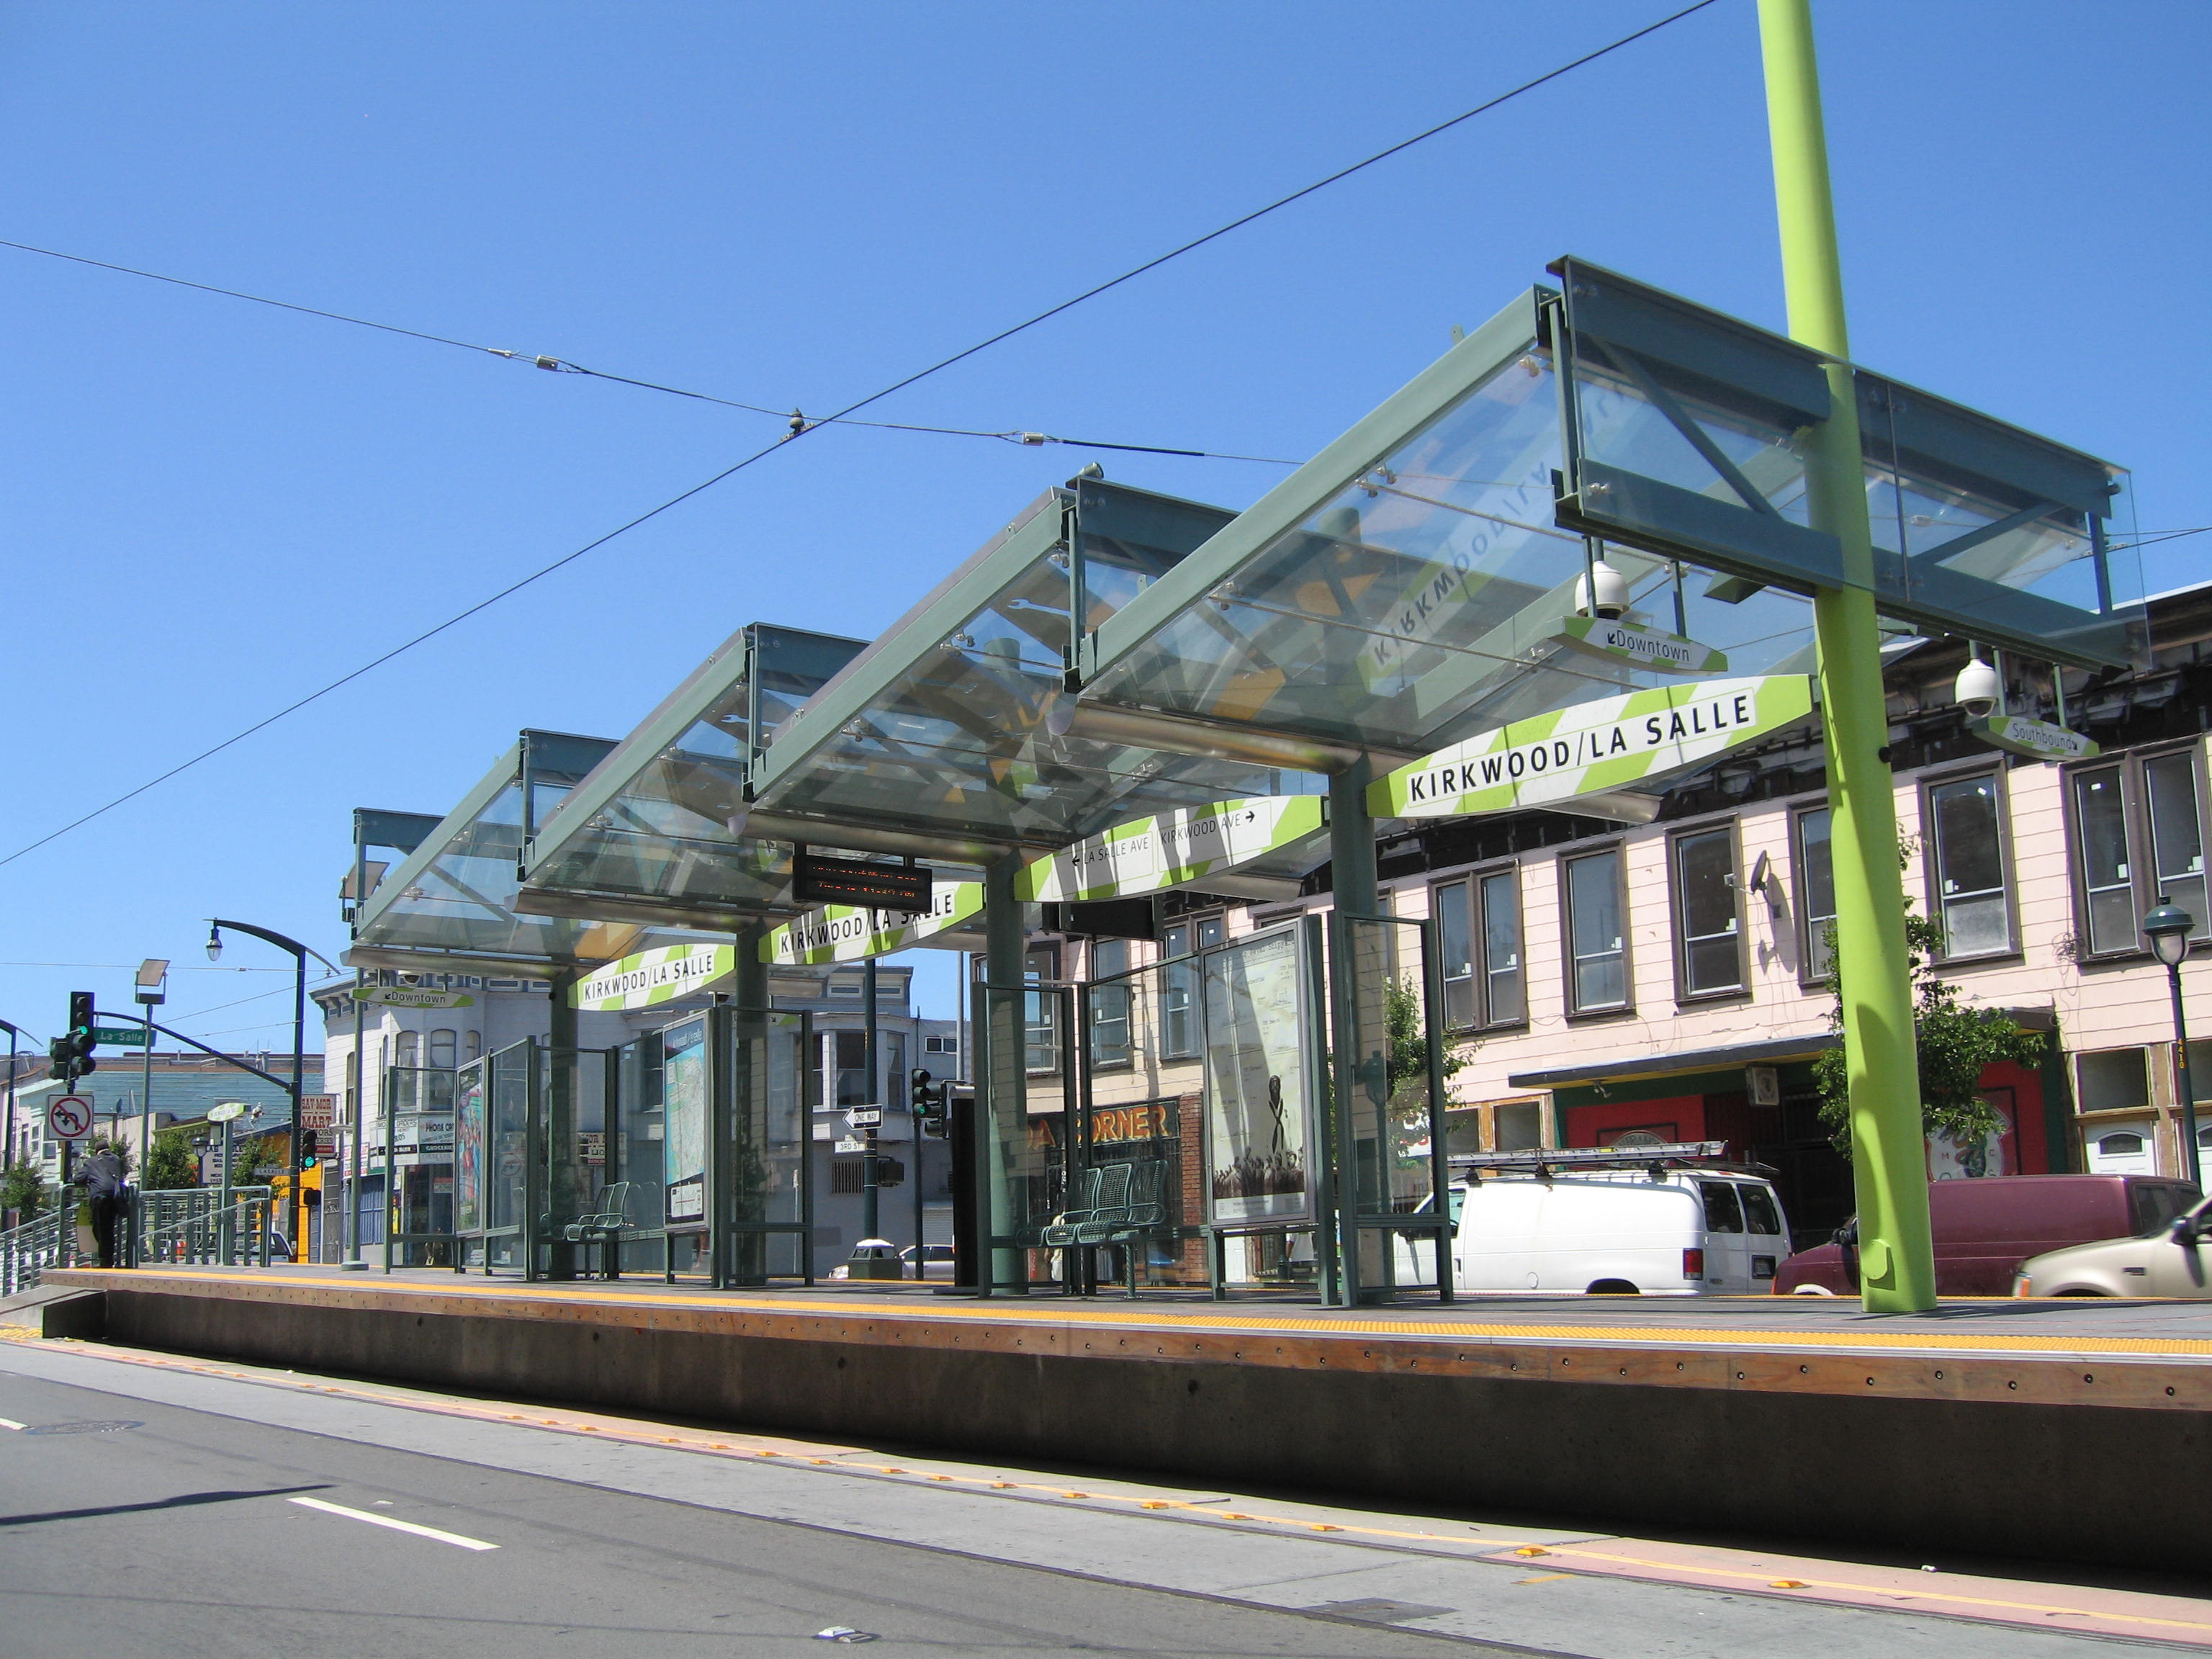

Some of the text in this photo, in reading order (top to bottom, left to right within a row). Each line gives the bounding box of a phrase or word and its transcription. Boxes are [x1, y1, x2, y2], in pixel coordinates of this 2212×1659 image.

[1617, 629, 1690, 662] Downtown
[1411, 695, 1750, 801] KIRKWOOD/LA SALLE
[2013, 722, 2072, 750] Southbound
[1161, 813, 1241, 845] KIRKWOOD AVE
[1084, 837, 1149, 864] LA SALLE AVE
[781, 894, 952, 953] KIRKWOOD/LA SLE
[585, 954, 712, 1001] KIRKWOOD/LA SALLE
[392, 992, 446, 1003] Downtown
[101, 1031, 143, 1042] La Salle
[302, 1116, 332, 1128] MART
[855, 1112, 877, 1123] ONE WAY
